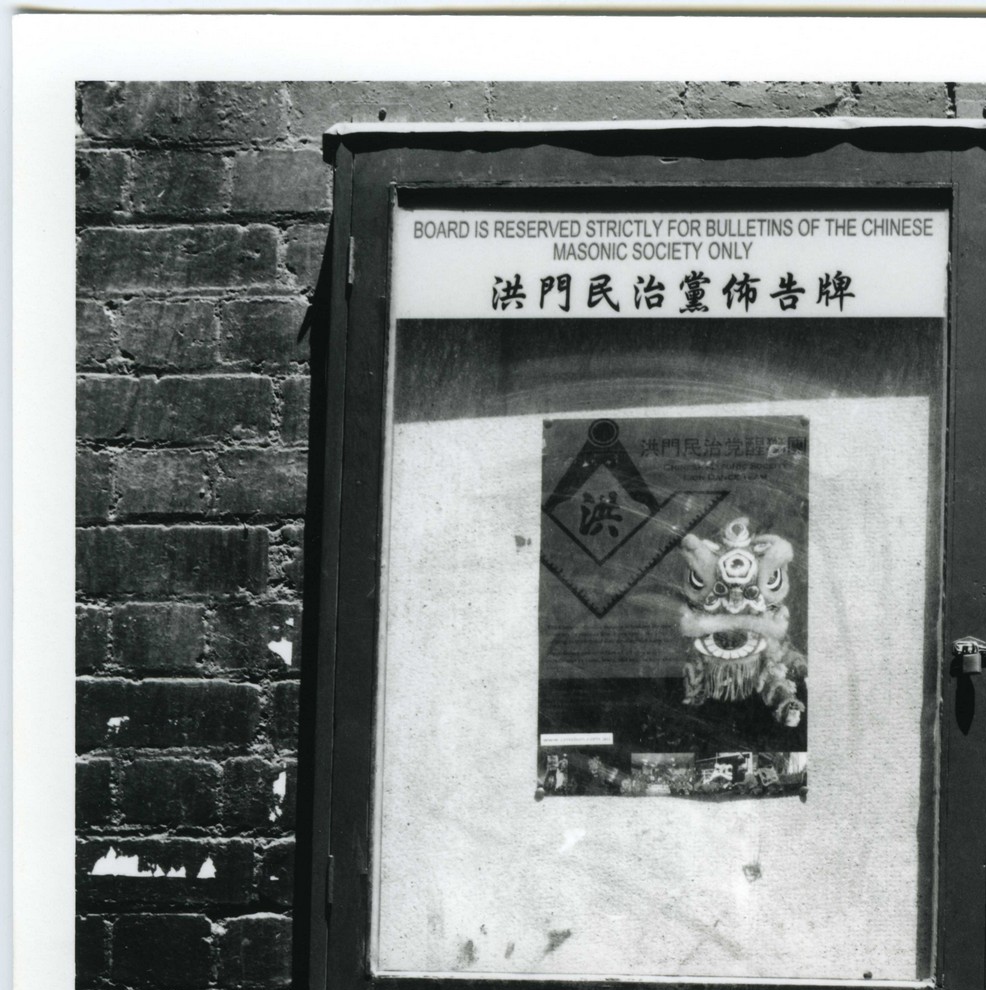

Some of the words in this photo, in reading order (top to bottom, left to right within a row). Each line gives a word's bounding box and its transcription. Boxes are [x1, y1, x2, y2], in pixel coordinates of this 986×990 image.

[414, 221, 470, 238] BOARD
[475, 221, 489, 238] IS
[494, 220, 582, 238] RESERVED
[586, 220, 664, 237] STRICTLY
[668, 219, 701, 237] FOR
[706, 219, 794, 237] BULLETINS
[798, 219, 820, 236] OF
[825, 218, 857, 236] THE
[862, 218, 933, 236] CHINESE
[553, 242, 628, 260] MASONIC
[633, 242, 702, 260] SOCIETY
[708, 242, 753, 260] ONLY
[492, 270, 856, 313] 洪門民治黨佈告牌
[579, 491, 623, 537] 洪
